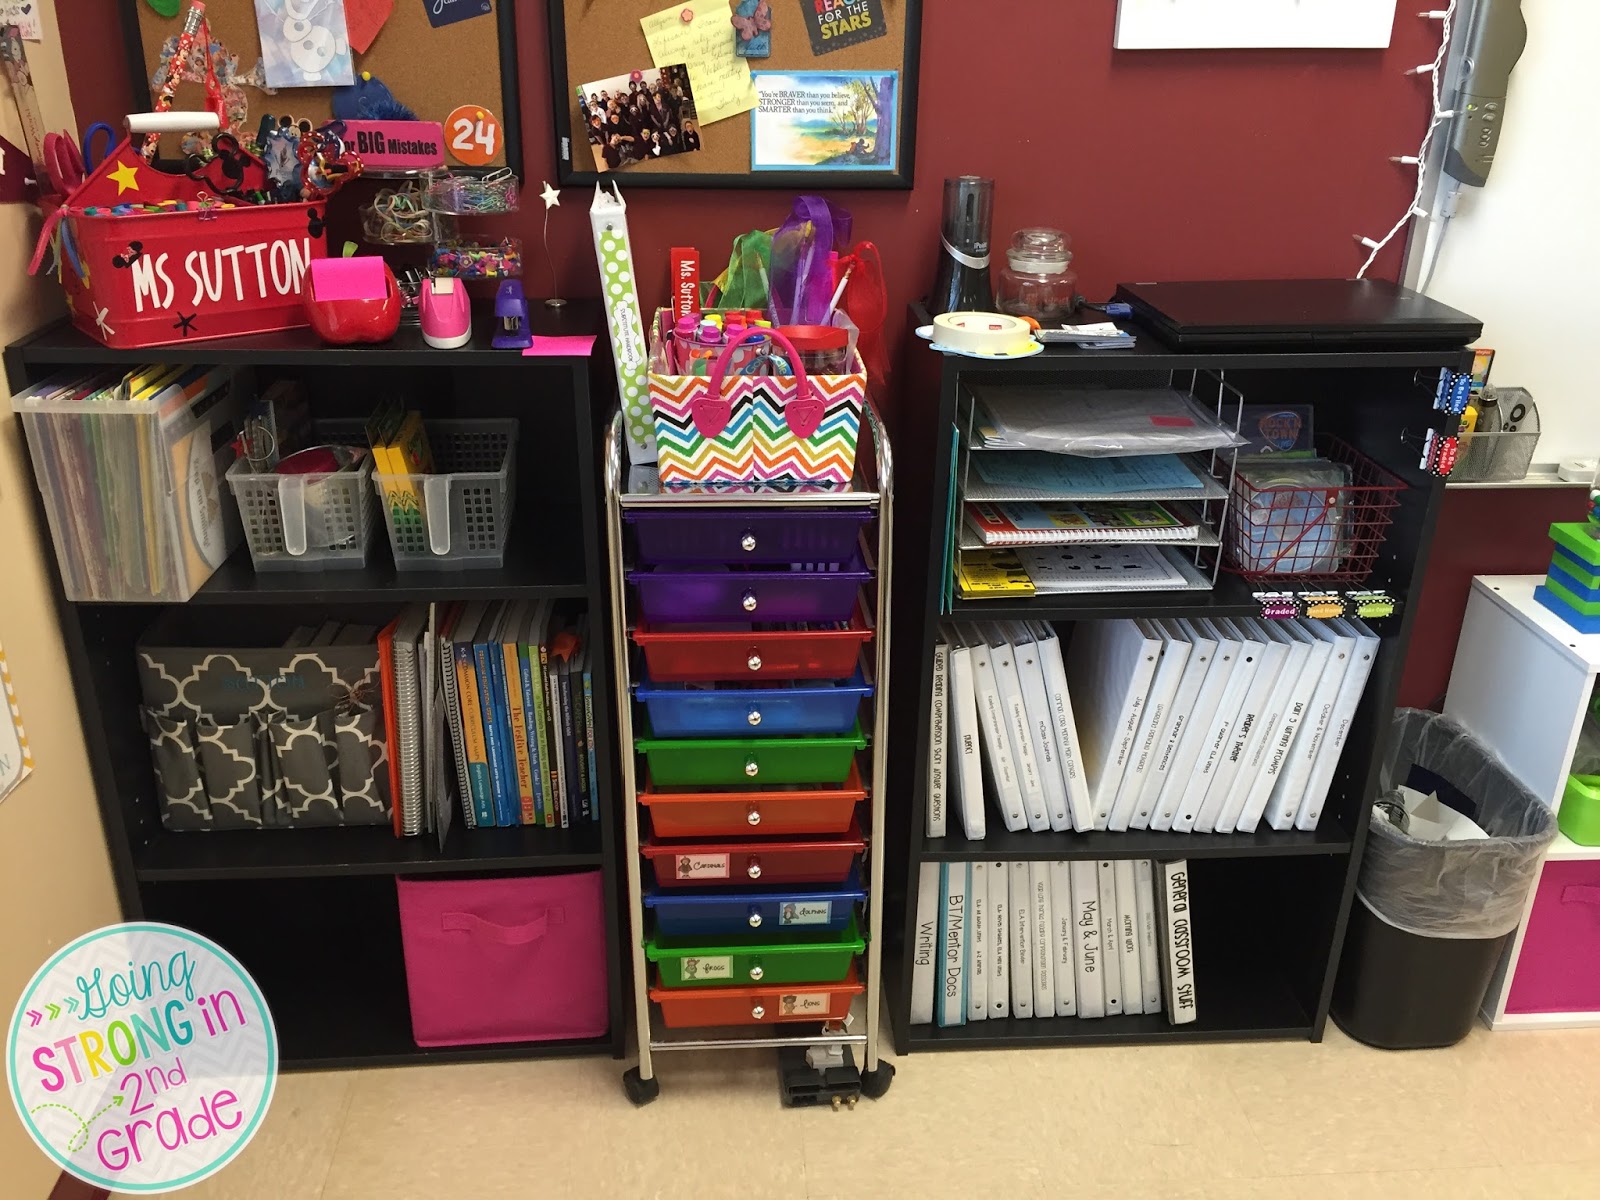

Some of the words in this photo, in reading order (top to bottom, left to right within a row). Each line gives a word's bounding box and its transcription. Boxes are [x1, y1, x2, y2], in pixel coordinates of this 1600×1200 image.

[814, 0, 860, 14] REA
[817, 9, 843, 25] FOR
[846, 1, 868, 16] THE
[820, 11, 872, 40] STARS
[758, 98, 796, 106] STRONGER
[357, 131, 385, 154] BIG
[387, 138, 438, 155] Mistakes
[452, 118, 495, 156] 24
[131, 252, 175, 312] MS
[184, 237, 310, 307] SUTTON
[680, 260, 696, 280] Ms.
[680, 282, 696, 316] Sutton
[1264, 608, 1296, 616] Graded
[512, 706, 522, 722] The
[1126, 713, 1137, 732] August
[1318, 703, 1331, 726] October
[514, 725, 526, 755] Festive
[1307, 732, 1321, 760] November
[1334, 719, 1349, 748] December
[1116, 736, 1130, 767] September
[517, 758, 528, 788] Teacher
[1078, 900, 1097, 927] May
[947, 894, 964, 964] BT/Mentor
[1082, 930, 1098, 940] &
[915, 921, 934, 966] Writing
[1106, 939, 1115, 951] April
[1083, 943, 1099, 973] June
[946, 967, 962, 998] Docs
